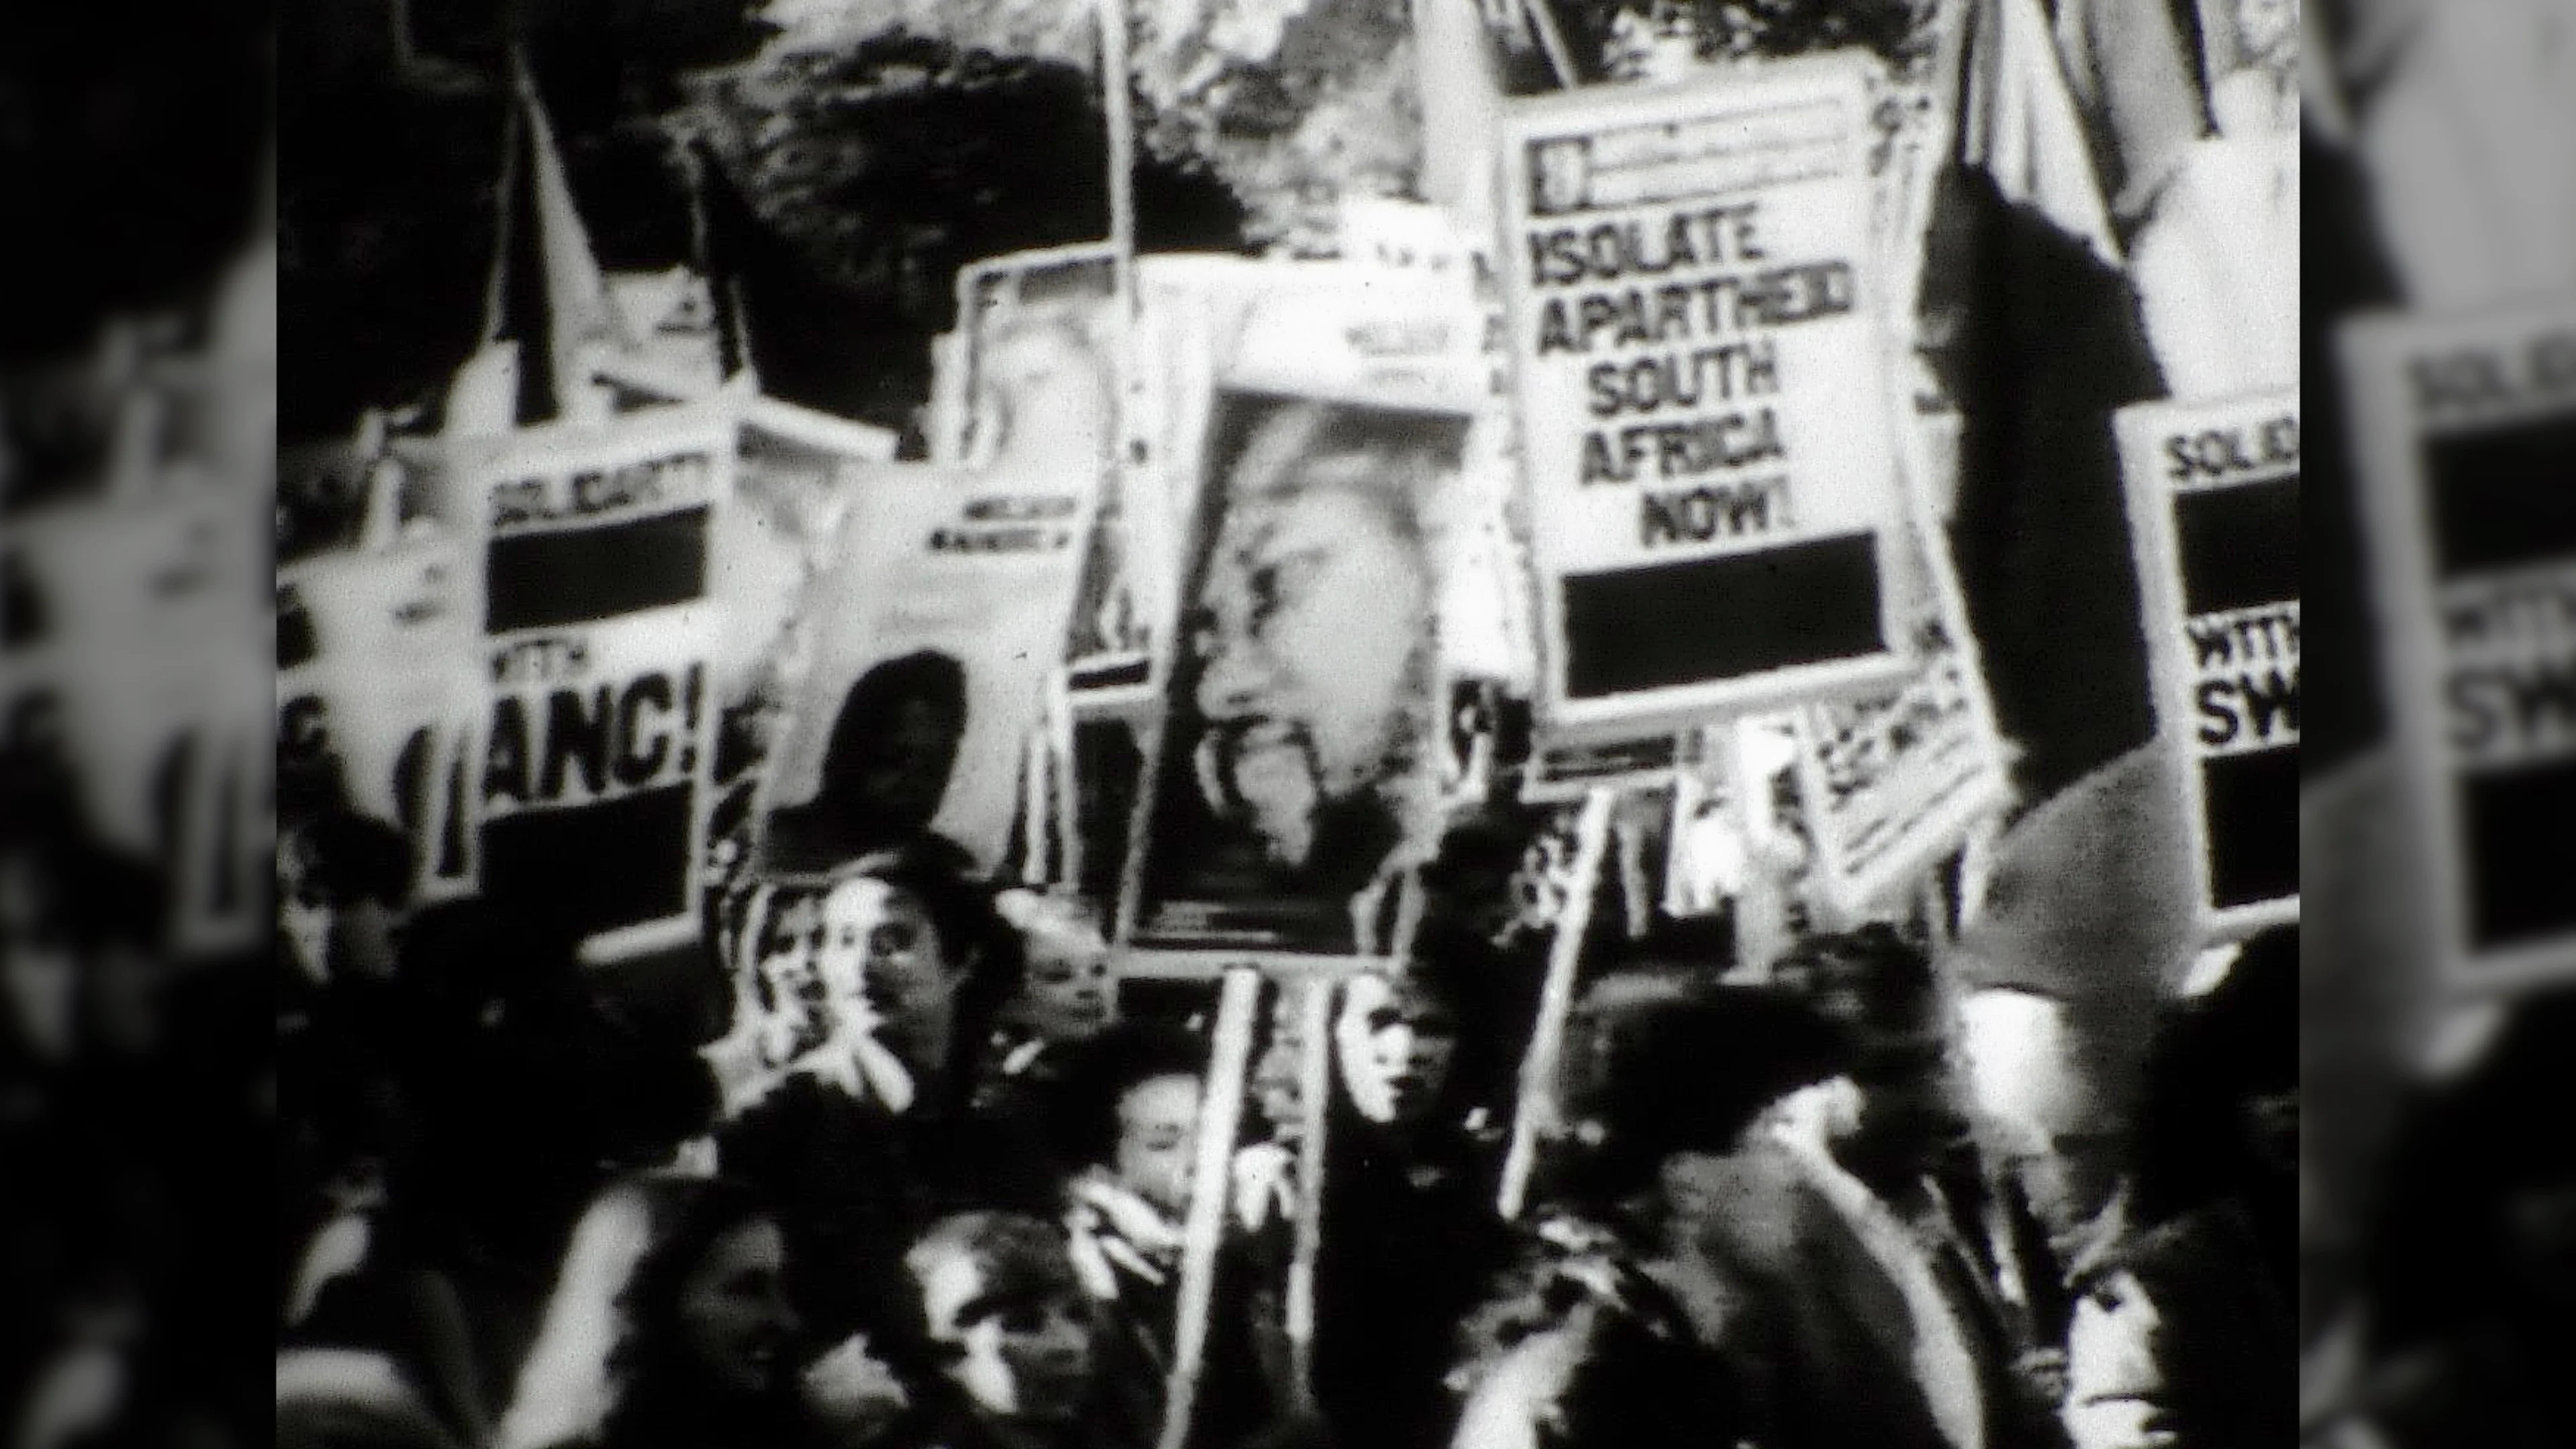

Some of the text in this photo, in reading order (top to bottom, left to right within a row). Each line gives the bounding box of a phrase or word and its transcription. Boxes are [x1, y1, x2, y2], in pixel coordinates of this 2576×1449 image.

[1527, 203, 1764, 288] ISOLATE
[1538, 258, 1849, 356] APARTHEID
[1587, 337, 1779, 416] SOUTH
[1580, 407, 1784, 486] AFRICA
[482, 660, 703, 805] ANC!
